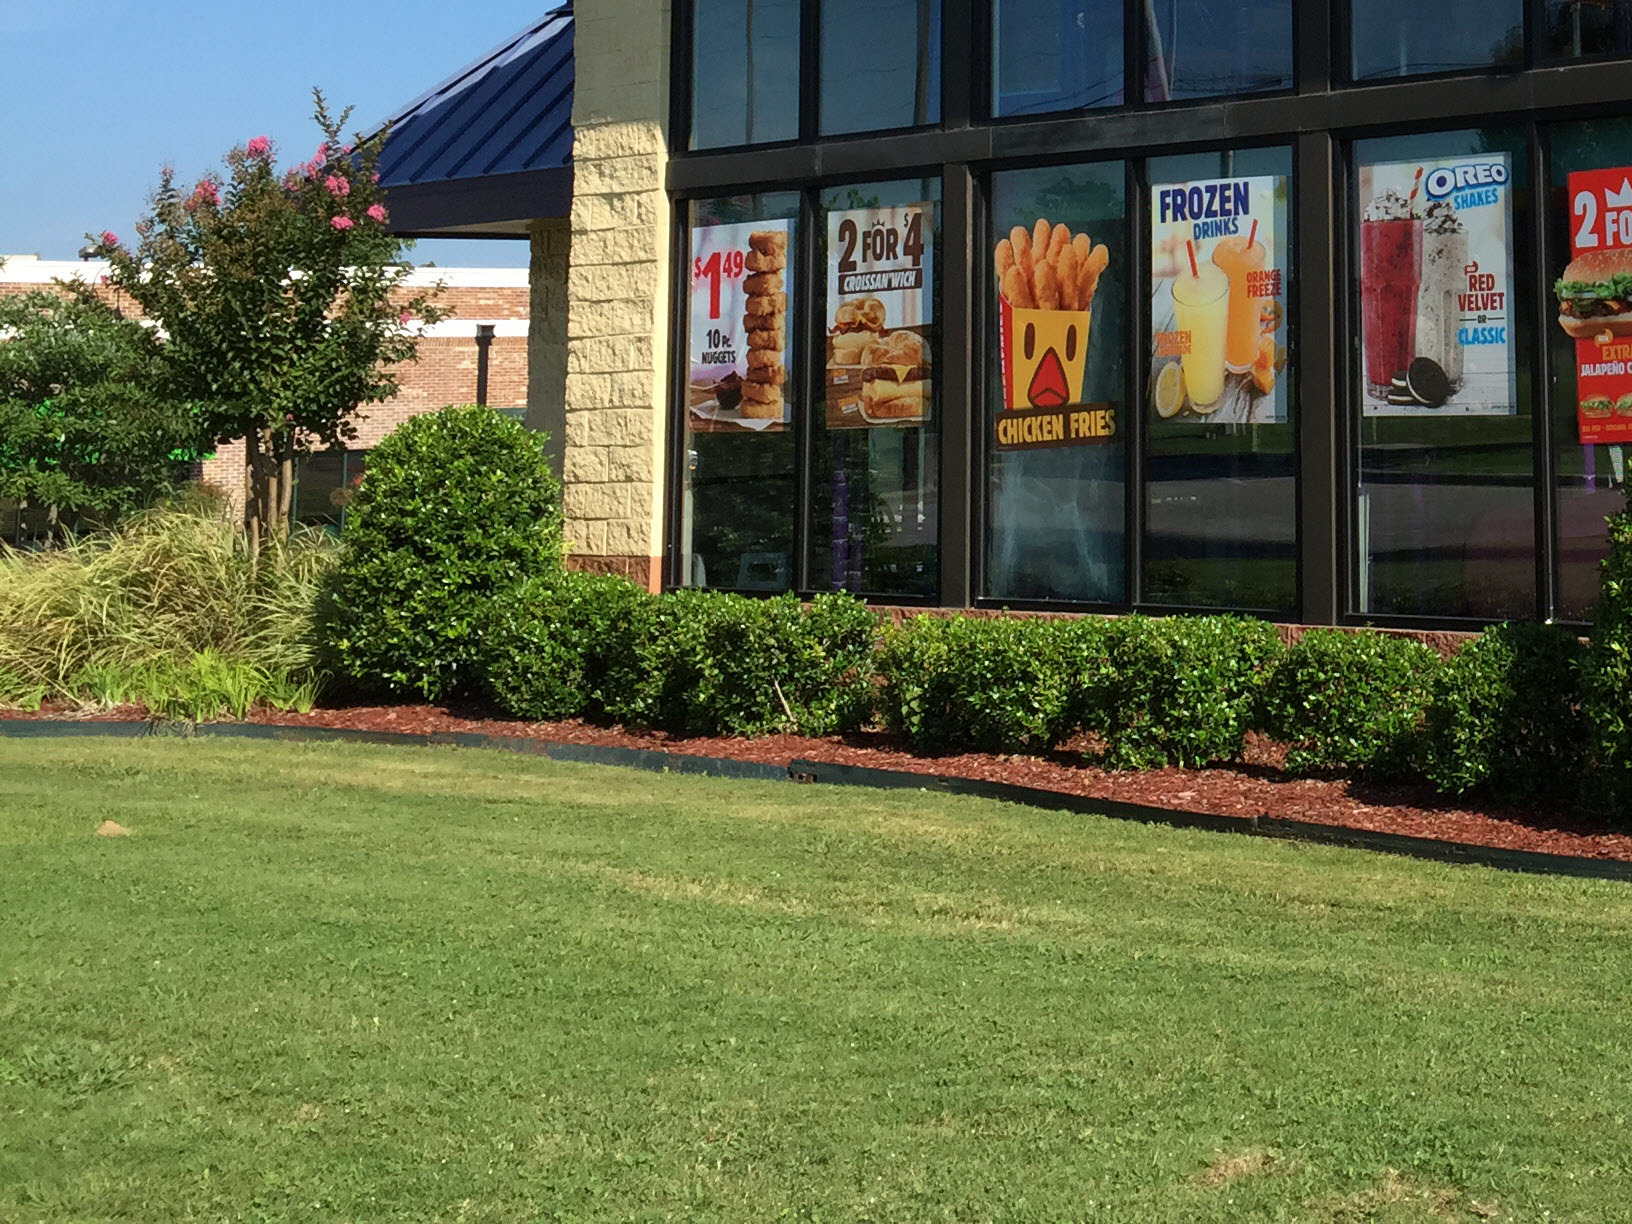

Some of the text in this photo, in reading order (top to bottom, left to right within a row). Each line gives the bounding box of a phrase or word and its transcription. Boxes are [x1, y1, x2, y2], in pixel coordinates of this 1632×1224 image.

[1426, 163, 1509, 198] OREO
[1160, 181, 1250, 224] FROZEN
[1453, 187, 1499, 211] SHAKES
[1193, 216, 1239, 241] DRINKS
[1574, 190, 1599, 248] 2
[838, 212, 925, 273] 2 FOR $4
[1246, 268, 1281, 284] ORANGE
[1468, 273, 1496, 292] RED
[1247, 282, 1282, 298] FREEZE
[1457, 292, 1505, 313] VELVET
[1477, 314, 1487, 324] OR
[706, 328, 720, 350] 10
[1456, 327, 1506, 346] CLASSIC
[701, 350, 737, 365] NUGGETS
[1581, 361, 1625, 377] JALAPEÑO
[998, 409, 1116, 445] CHICKEN FRIES
